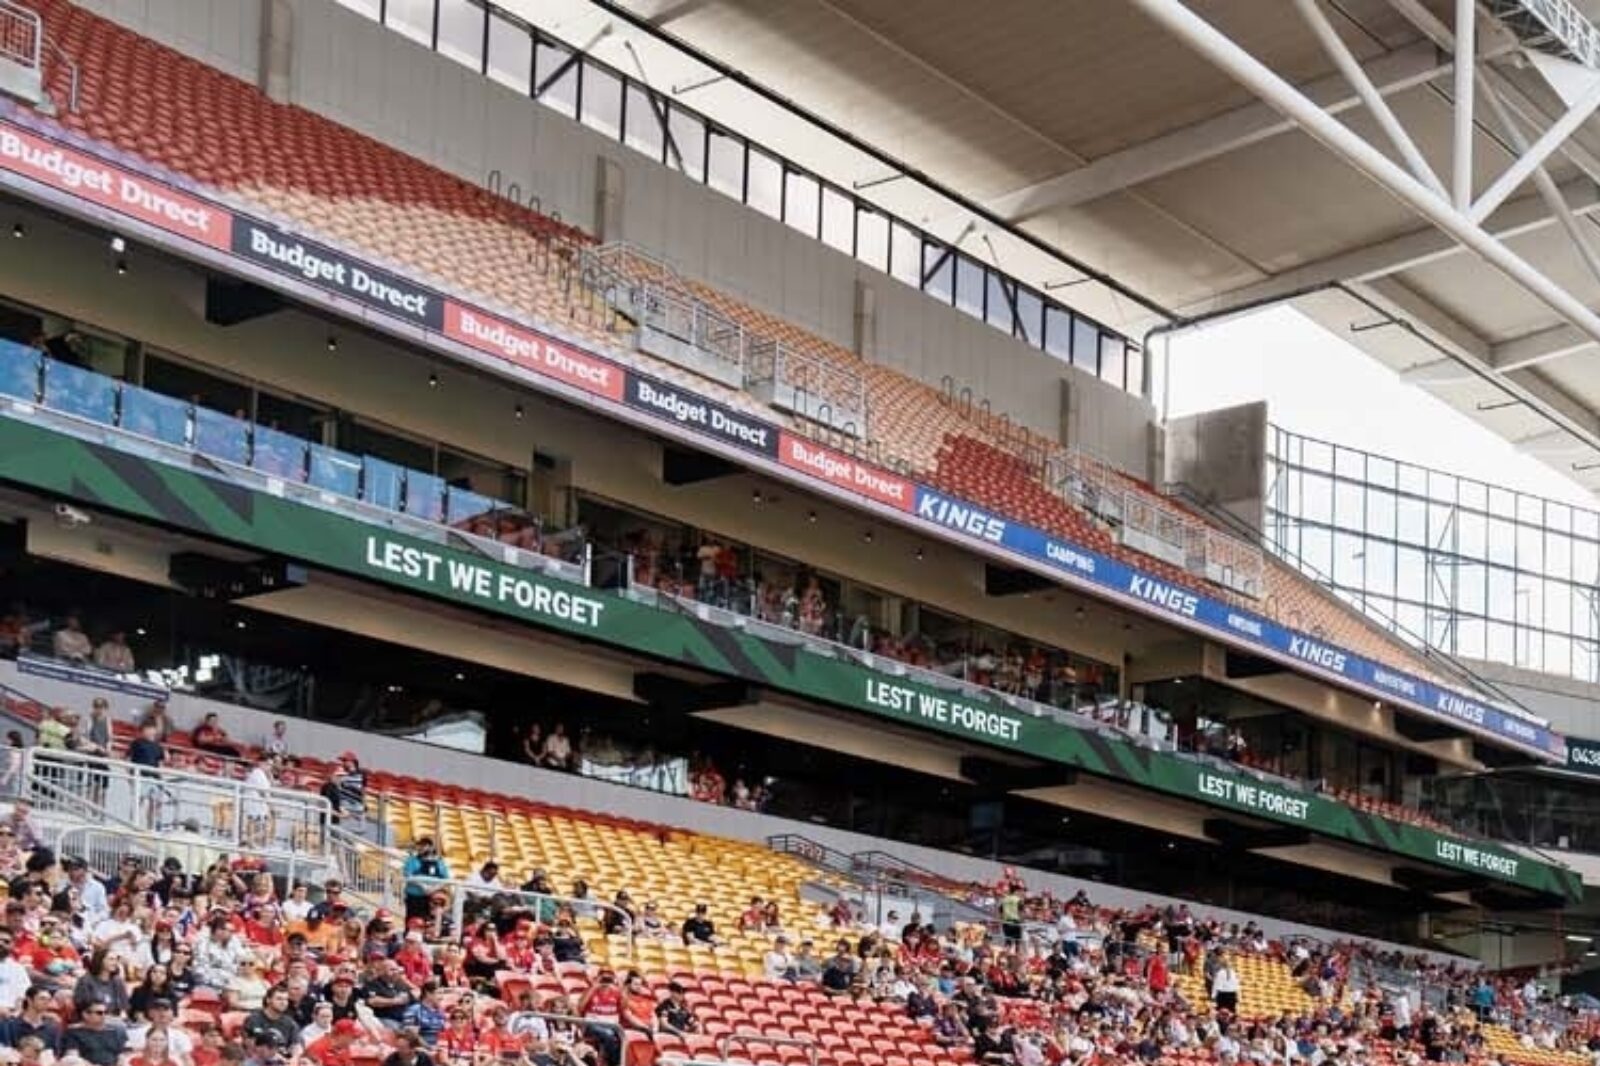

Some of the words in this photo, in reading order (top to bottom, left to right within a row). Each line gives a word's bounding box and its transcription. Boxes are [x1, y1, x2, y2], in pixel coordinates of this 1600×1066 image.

[1, 131, 114, 195] Budget
[120, 175, 210, 231] Direct
[250, 228, 345, 287] Budget
[351, 266, 427, 317] Direct
[460, 312, 540, 366] Budget
[545, 347, 609, 388] Direct
[638, 382, 706, 428] Budget
[711, 412, 767, 447] Direct
[792, 442, 851, 482] Budget
[855, 466, 905, 500] Direct
[919, 493, 1006, 542] KINGS
[367, 535, 443, 589] LEST
[448, 558, 492, 599] WE
[498, 574, 604, 628] FORGET
[1130, 574, 1199, 616] KINGS
[1288, 637, 1347, 673] KINGS
[866, 678, 915, 715] LEST
[919, 691, 949, 723] WE
[950, 700, 1023, 743] FORGET
[1437, 695, 1486, 725] KINGS
[1198, 774, 1233, 801] LEST
[1236, 784, 1258, 808] WE
[1259, 790, 1309, 820] FORGET
[1436, 840, 1463, 864] LEST
[1463, 848, 1480, 868] WE
[1480, 851, 1518, 878] FORGET
